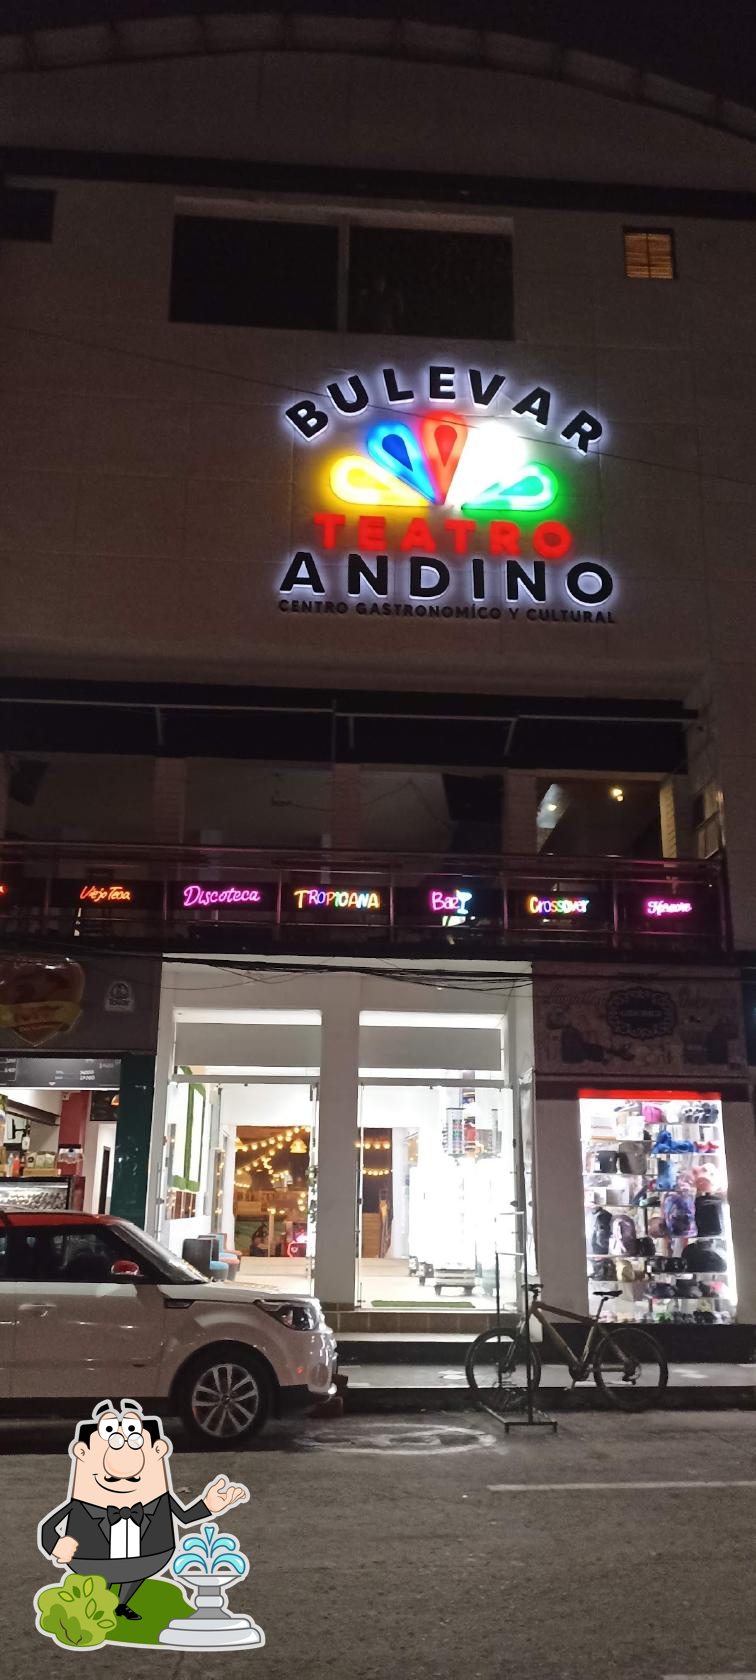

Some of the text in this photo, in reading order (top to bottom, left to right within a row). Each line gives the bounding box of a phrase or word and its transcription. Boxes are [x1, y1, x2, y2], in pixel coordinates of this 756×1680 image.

[285, 366, 603, 455] BULEVAR
[314, 513, 572, 559] TEATRO
[280, 552, 614, 605] ANDINO
[278, 600, 349, 614] CENTRO
[508, 607, 519, 620] Y
[526, 608, 616, 624] CULTURAL
[184, 886, 260, 906] Discoteca
[530, 896, 590, 913] Crossover
